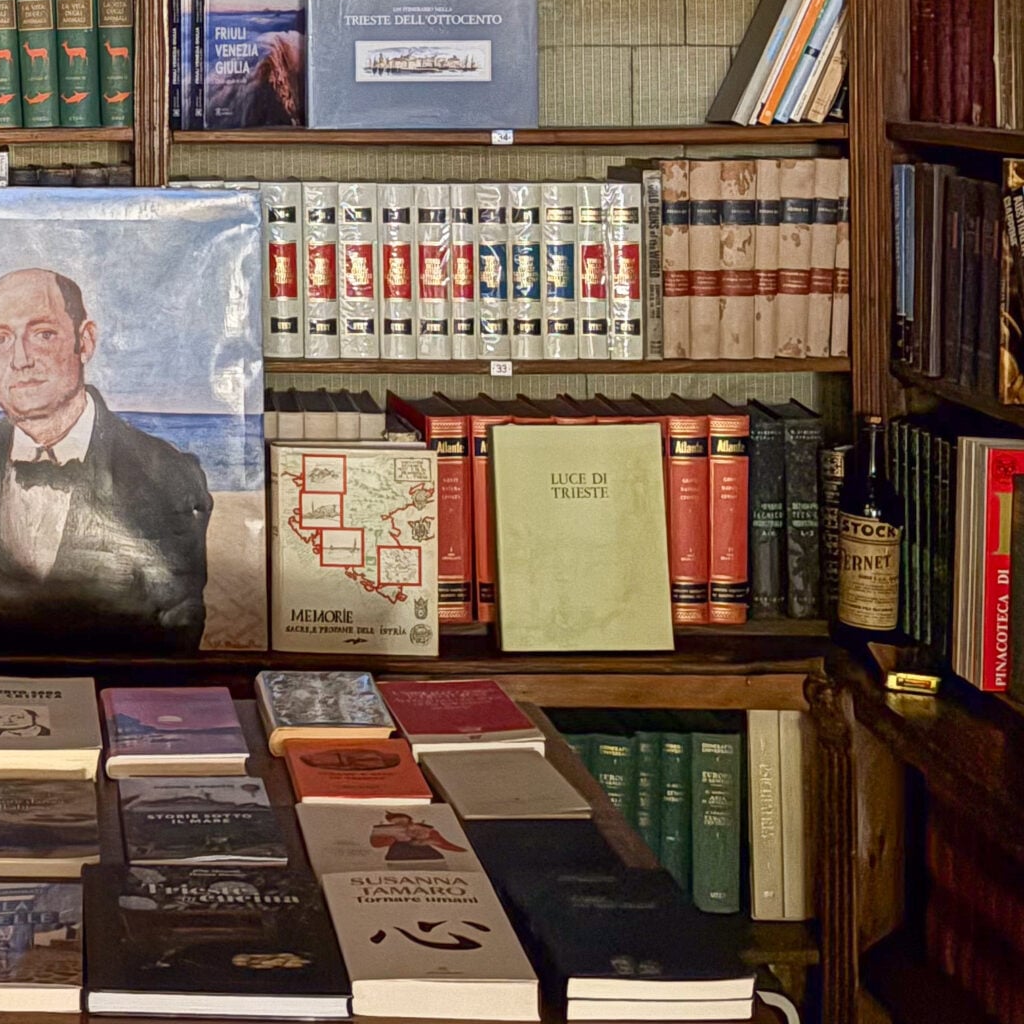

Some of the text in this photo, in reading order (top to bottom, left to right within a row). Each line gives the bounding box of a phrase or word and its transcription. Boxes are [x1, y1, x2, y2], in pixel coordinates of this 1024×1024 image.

[344, 14, 503, 26] TRIESTE DELL'OTTOCENTO
[215, 27, 247, 40] FRIULI
[215, 44, 259, 57] VENEZIA
[215, 61, 250, 75] GIULIA
[436, 441, 465, 454] Atlante
[675, 441, 704, 454] Atlante
[551, 473, 607, 485] LUCE DI
[551, 487, 609, 499] TRIESTE
[841, 519, 897, 538] STOCK
[290, 608, 354, 624] MEMORIE
[995, 569, 1010, 687] PINACOTECA DI
[350, 876, 469, 886] SUSANNA
[142, 883, 247, 895] Trieste
[362, 886, 467, 896] TAMARO
[356, 896, 479, 904] Tornare umani
